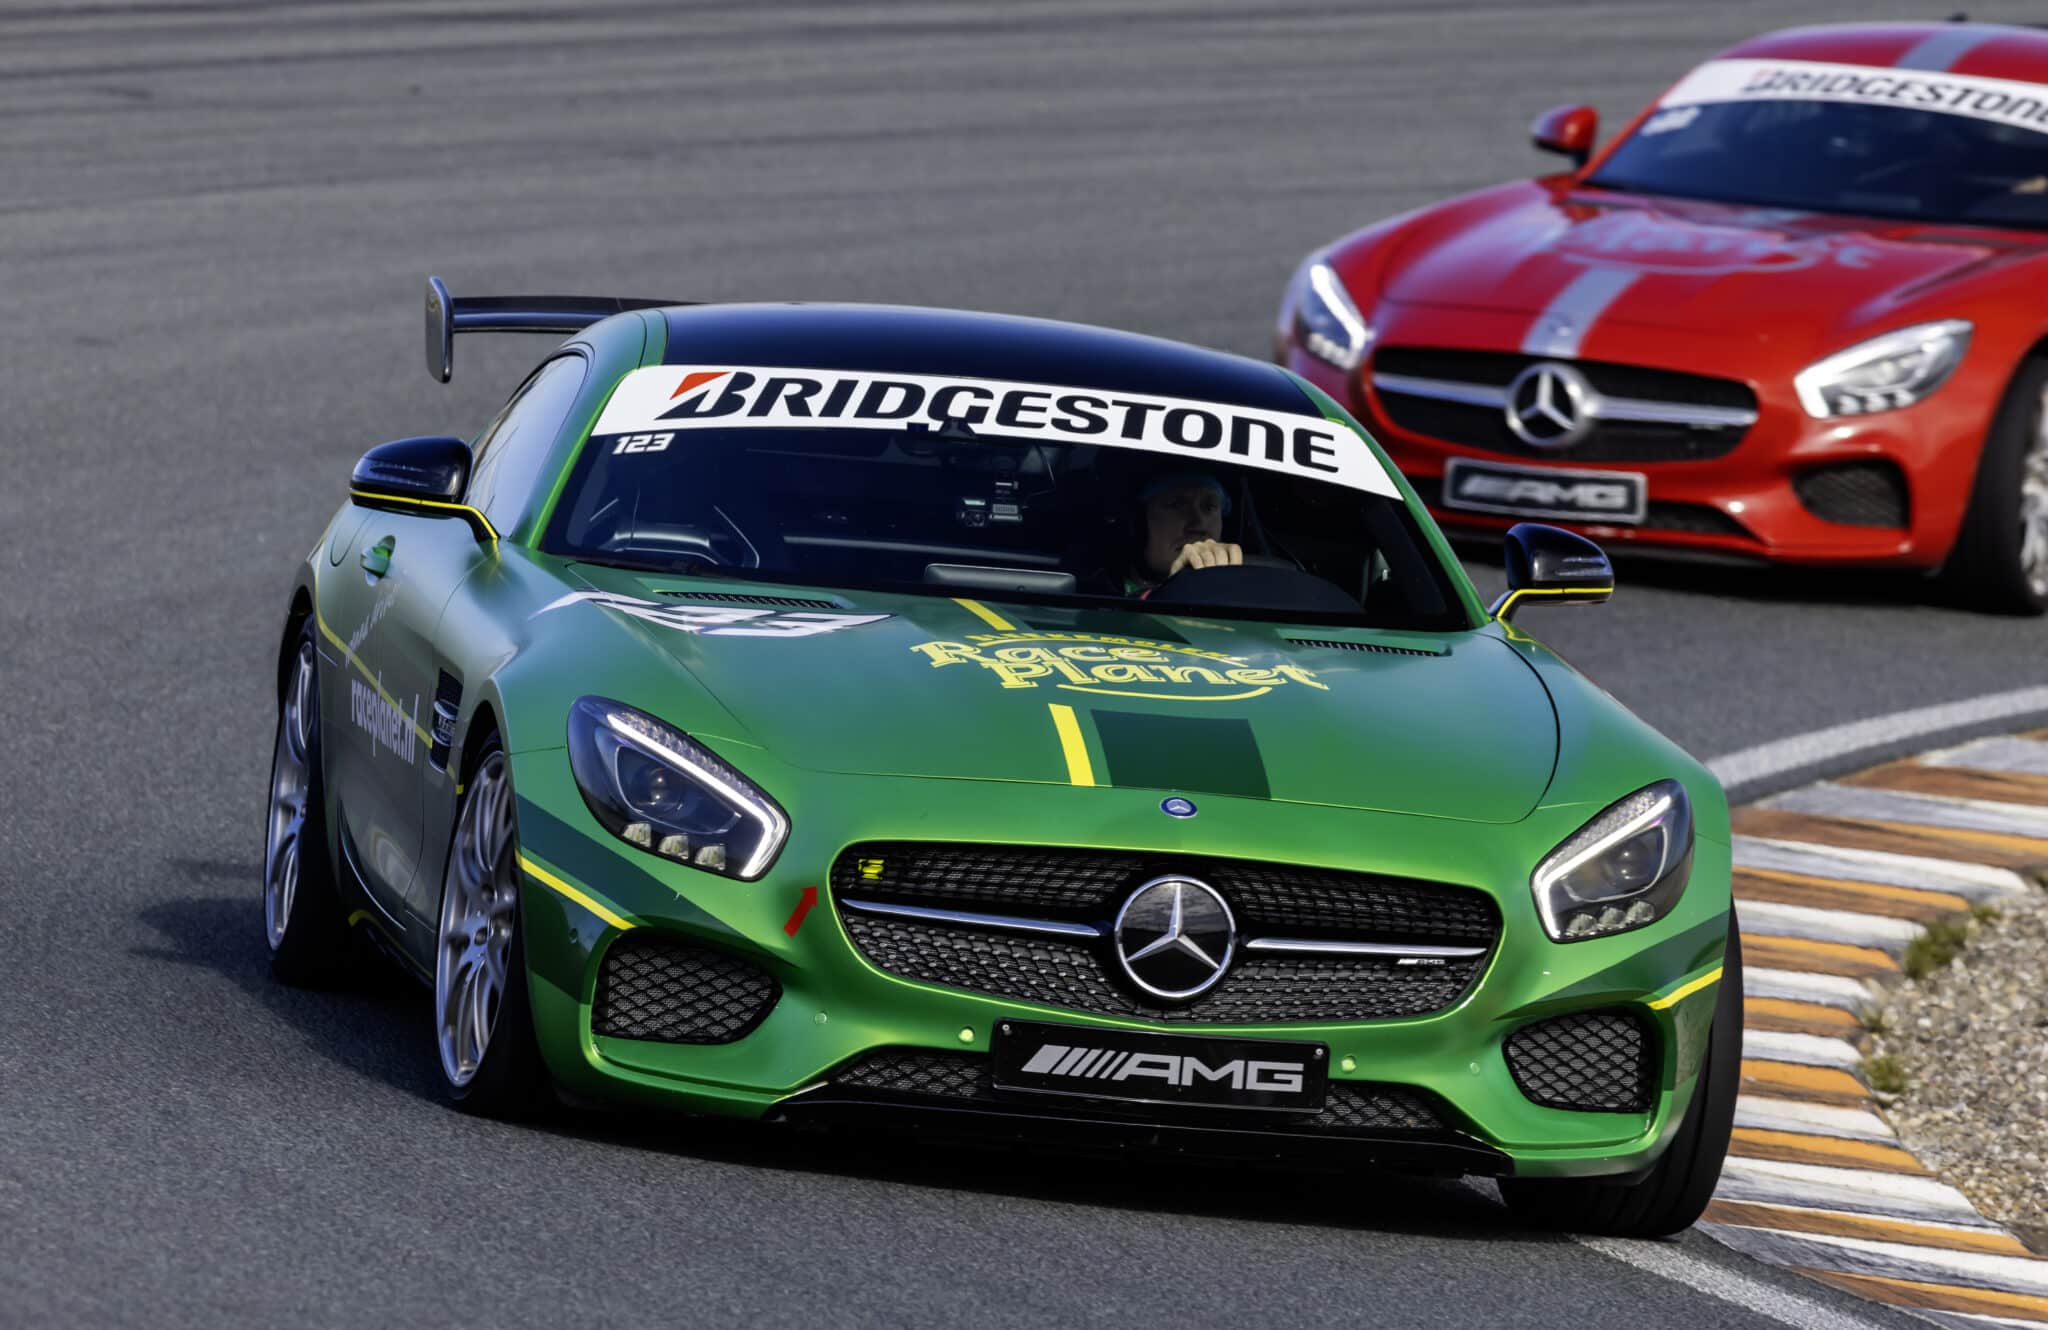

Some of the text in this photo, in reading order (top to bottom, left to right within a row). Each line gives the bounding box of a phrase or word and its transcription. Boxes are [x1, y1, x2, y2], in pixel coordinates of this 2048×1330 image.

[654, 371, 1340, 473] BRIDGESTONE
[612, 433, 675, 455] 123
[910, 641, 1170, 668] Race
[980, 660, 1330, 690] Planet
[1111, 1052, 1304, 1094] AMG
